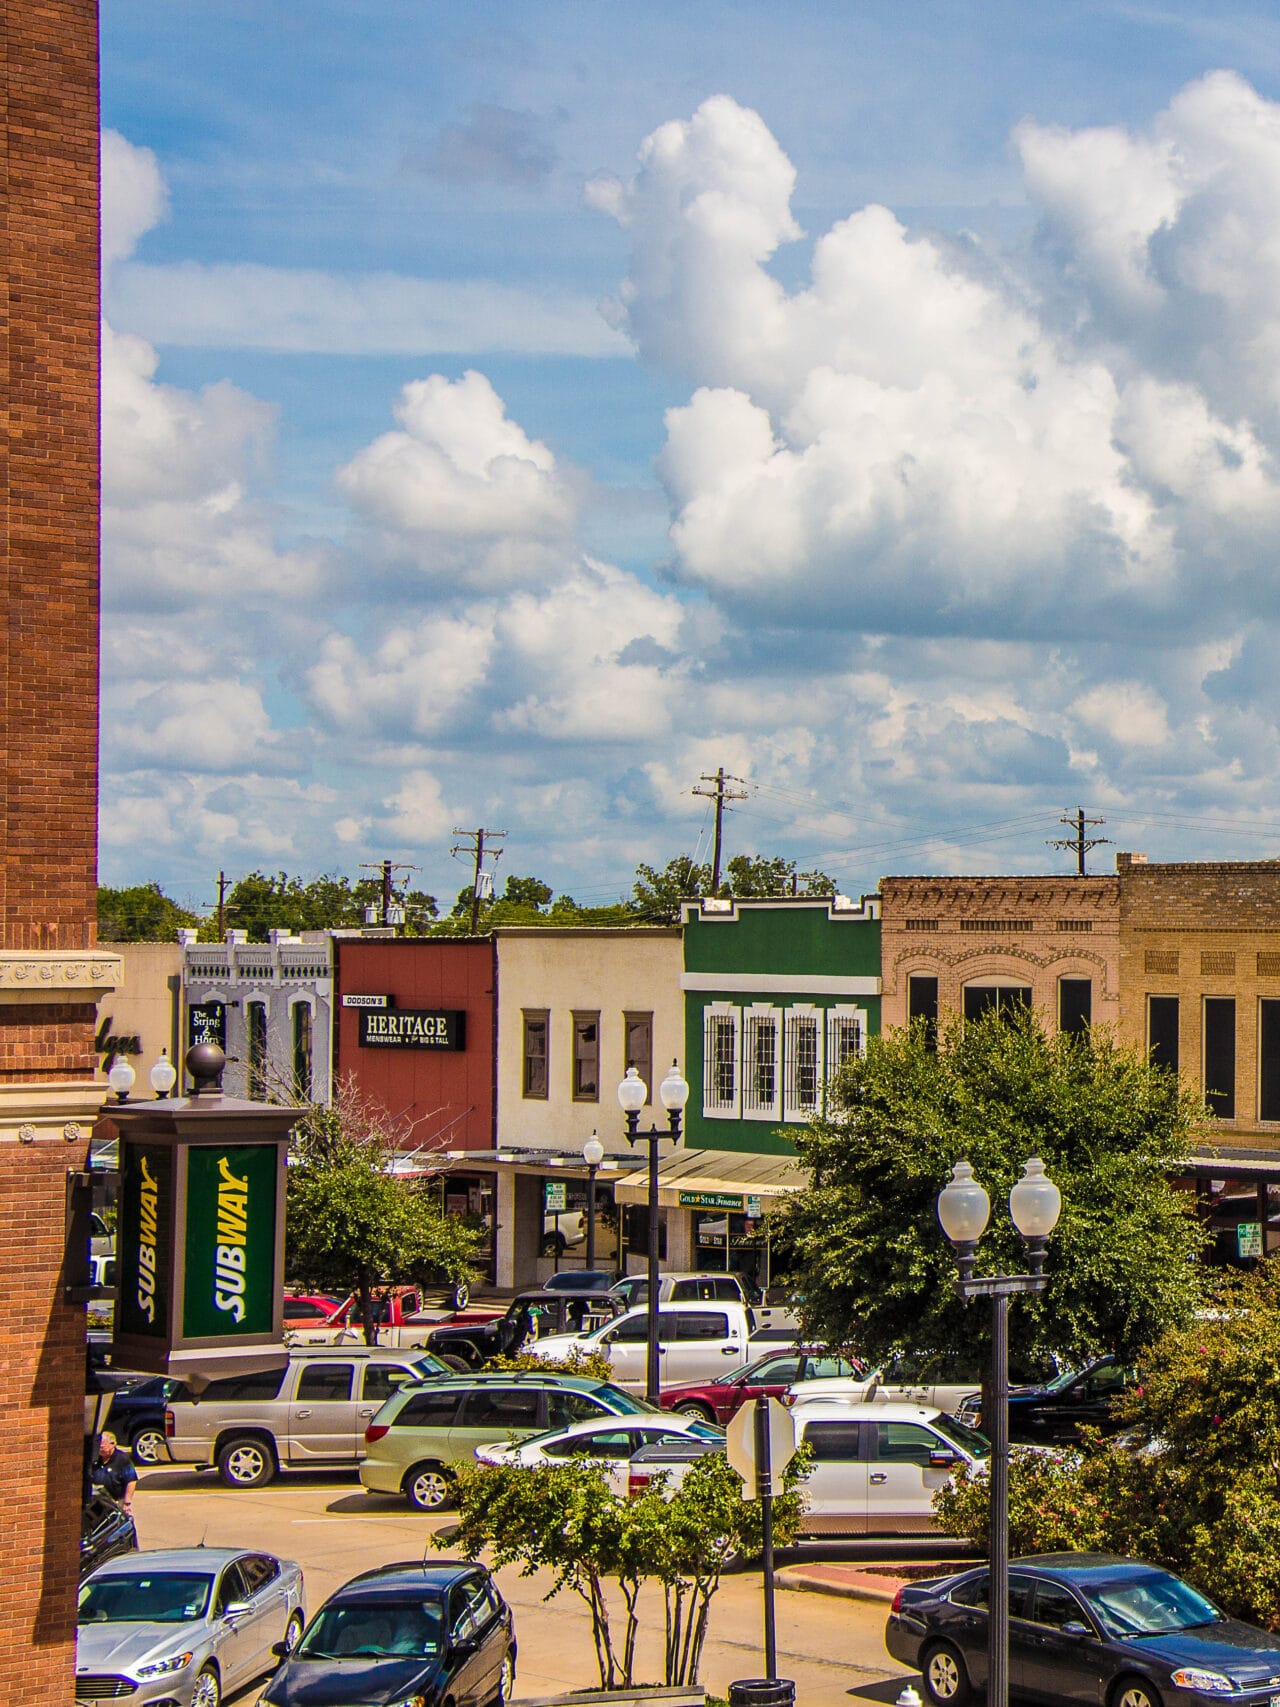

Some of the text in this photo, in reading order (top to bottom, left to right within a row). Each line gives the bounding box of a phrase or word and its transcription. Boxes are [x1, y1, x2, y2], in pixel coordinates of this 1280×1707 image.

[347, 997, 383, 1005] DODSON'S
[193, 1010, 207, 1018] The
[193, 1017, 220, 1028] String
[367, 1015, 447, 1036] HERITAGE
[366, 1035, 401, 1043] MENSWEAR
[419, 1036, 429, 1044] BIG
[435, 1037, 449, 1045] TALL
[715, 1195, 742, 1207] Finance
[138, 1156, 158, 1323] SUBWAY
[214, 1157, 248, 1324] SUBWAY
